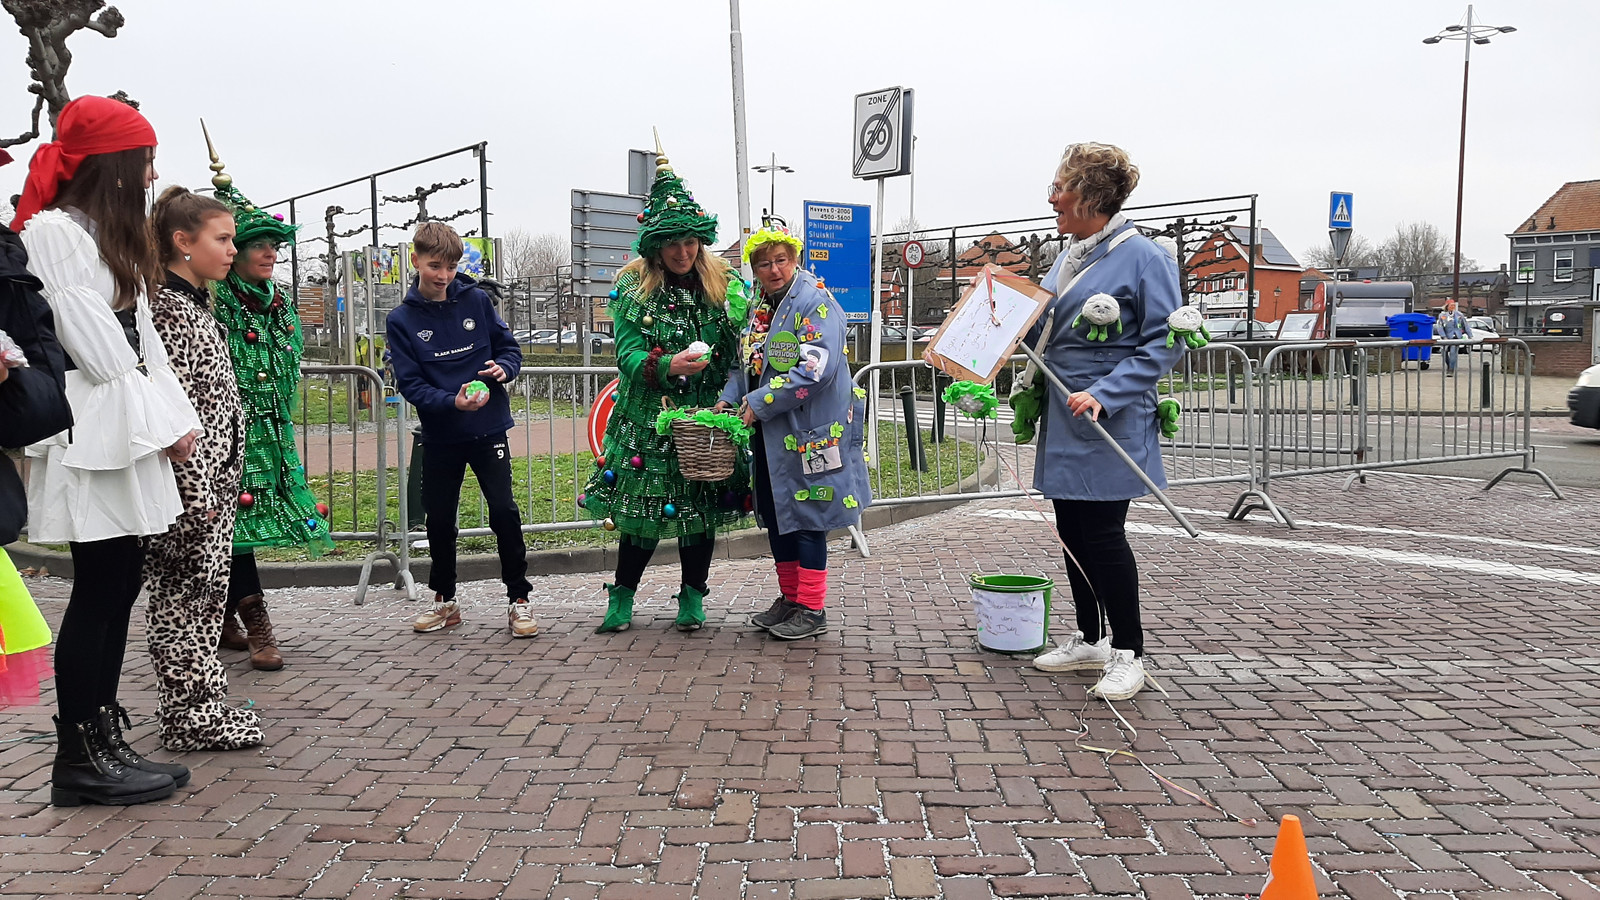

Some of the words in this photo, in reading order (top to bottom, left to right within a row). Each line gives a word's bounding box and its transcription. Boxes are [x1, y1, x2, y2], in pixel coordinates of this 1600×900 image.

[868, 95, 887, 105] ZONE
[808, 222, 843, 230] Philippine
[808, 231, 835, 239] Sluiskil
[808, 240, 844, 248] Terneuzen
[770, 341, 797, 351] HAPPY
[769, 350, 799, 359] BIRTHDAY
[497, 449, 505, 460] 9
